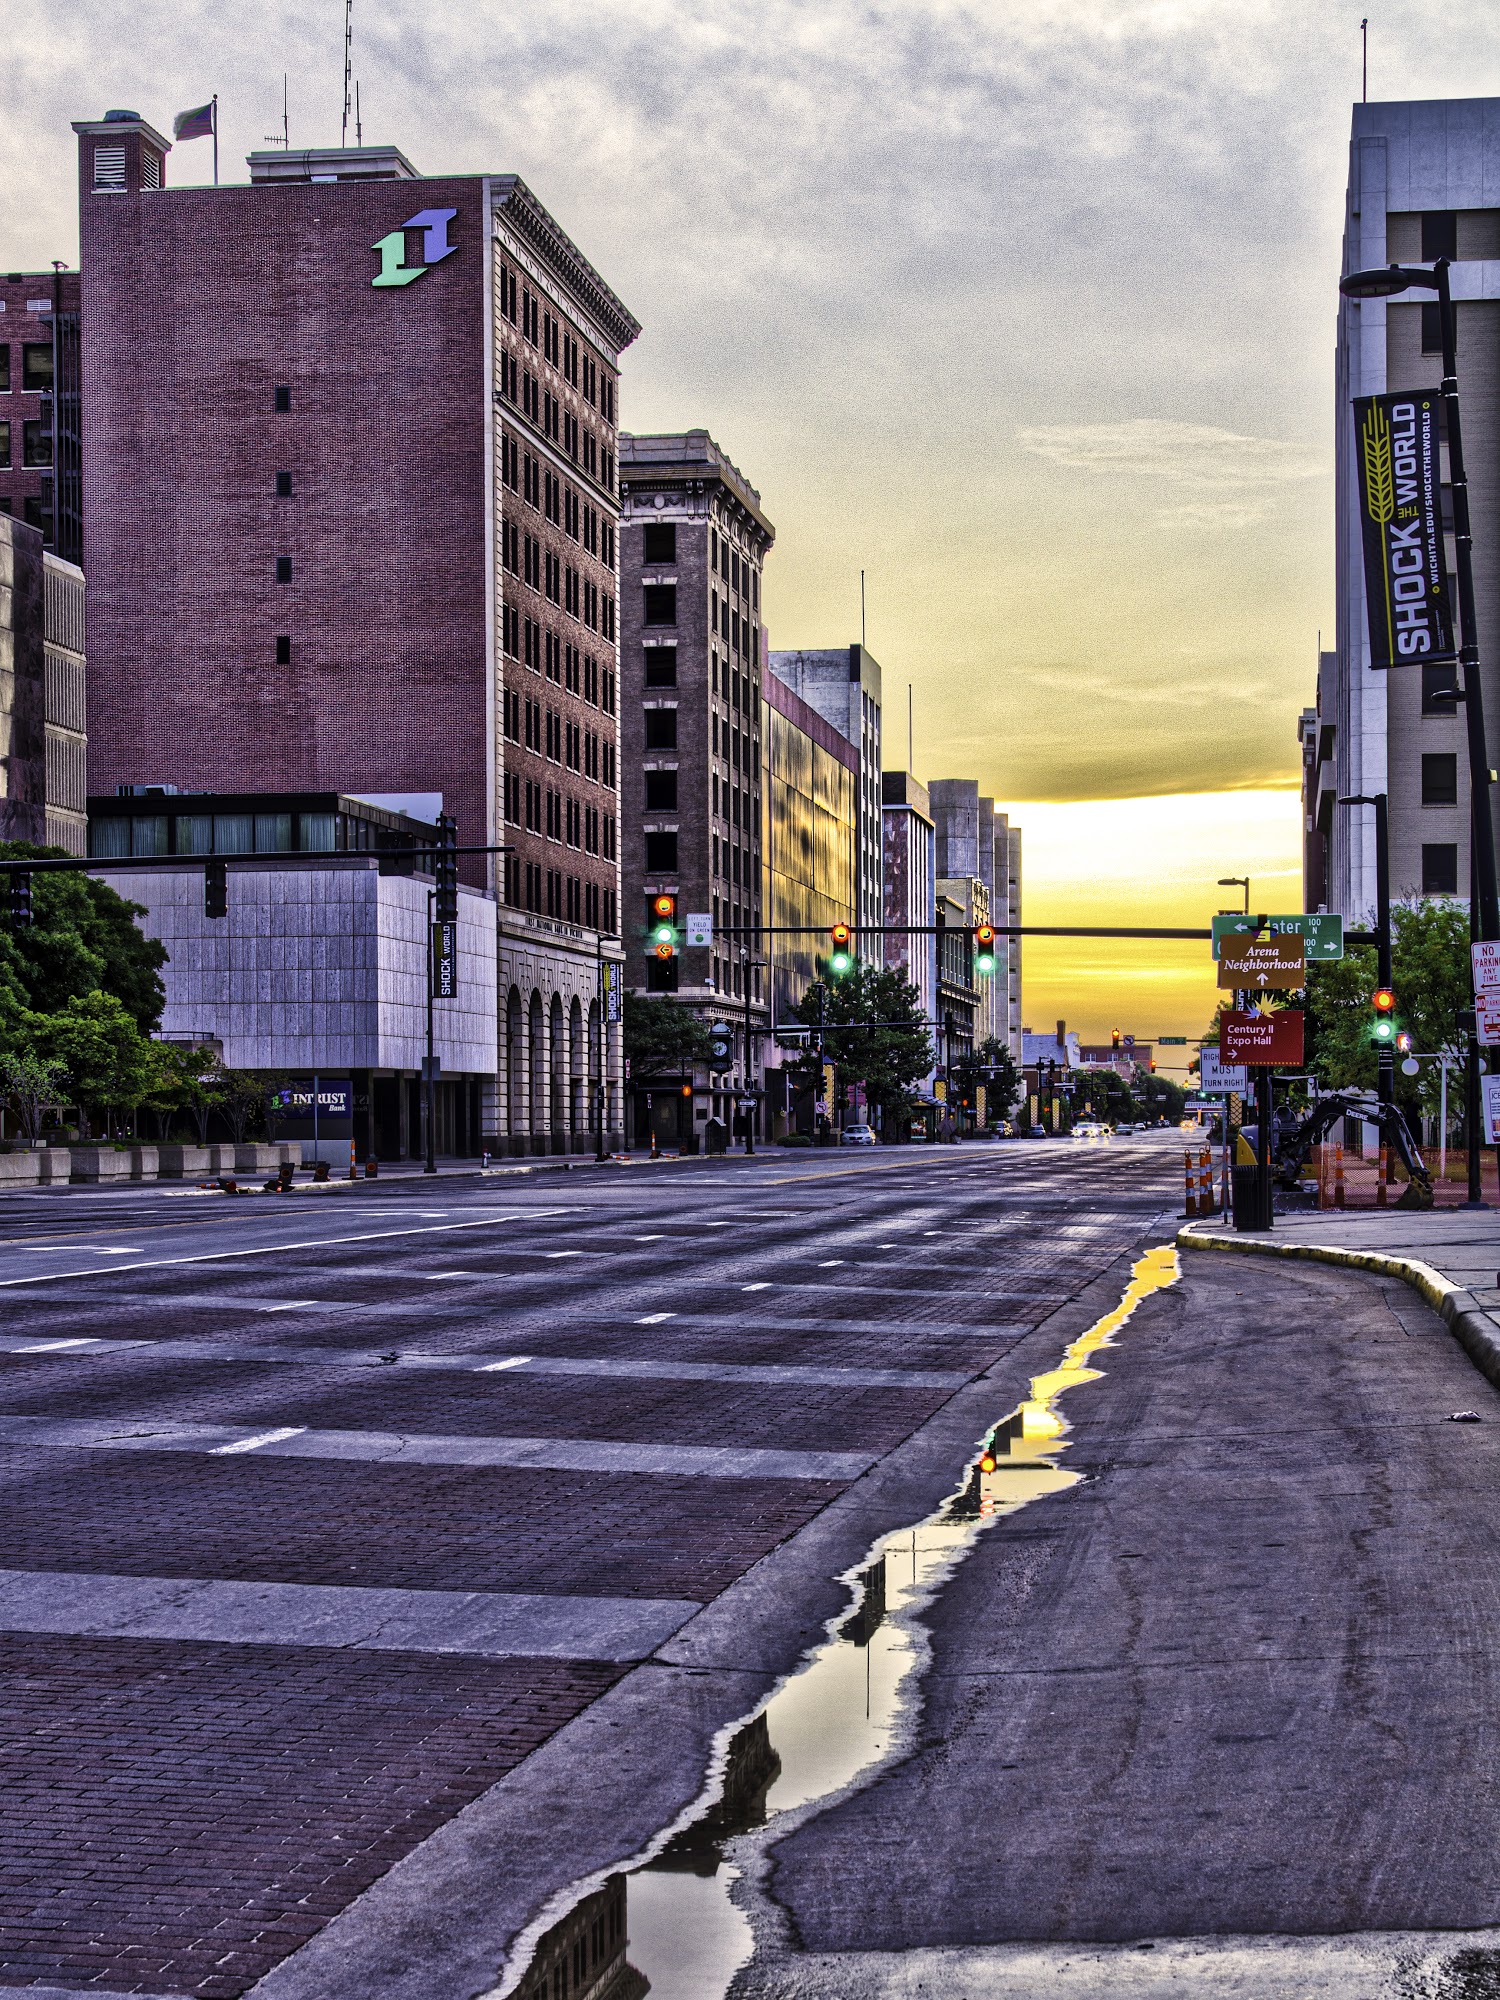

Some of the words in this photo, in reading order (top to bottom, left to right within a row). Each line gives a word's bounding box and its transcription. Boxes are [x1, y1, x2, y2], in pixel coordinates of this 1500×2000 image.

[1392, 403, 1418, 506] WORLD
[1422, 411, 1439, 585] WICHITA.EDU/SHOCKTHEWORLD
[1397, 505, 1420, 519] THE
[1389, 518, 1431, 655] SHOCK
[1267, 920, 1301, 934] ater
[1308, 918, 1321, 926] 100
[1312, 927, 1318, 935] N
[443, 925, 451, 955] WORLD
[1246, 946, 1279, 956] Arena
[1307, 947, 1312, 955] S
[1482, 946, 1494, 957] NO
[1224, 958, 1302, 973] Neighborhood
[1475, 957, 1500, 968] PARKIN
[441, 958, 451, 995] SHOCK
[1483, 967, 1496, 975] ANY
[1482, 975, 1498, 983] TIME
[608, 990, 617, 1020] SHOCK
[1477, 998, 1486, 1009] NO
[1227, 1025, 1266, 1035] Century
[1268, 1025, 1274, 1034] II
[1160, 1037, 1176, 1045] Main
[1227, 1036, 1251, 1046] Expo
[1253, 1036, 1271, 1045] Hall
[1203, 1053, 1220, 1061] RIGH
[1212, 1065, 1236, 1075] MUST
[1204, 1079, 1222, 1087] TURN
[1224, 1078, 1244, 1086] RIGHT
[293, 1093, 346, 1104] INTRUST
[1346, 1108, 1369, 1121] DEERE
